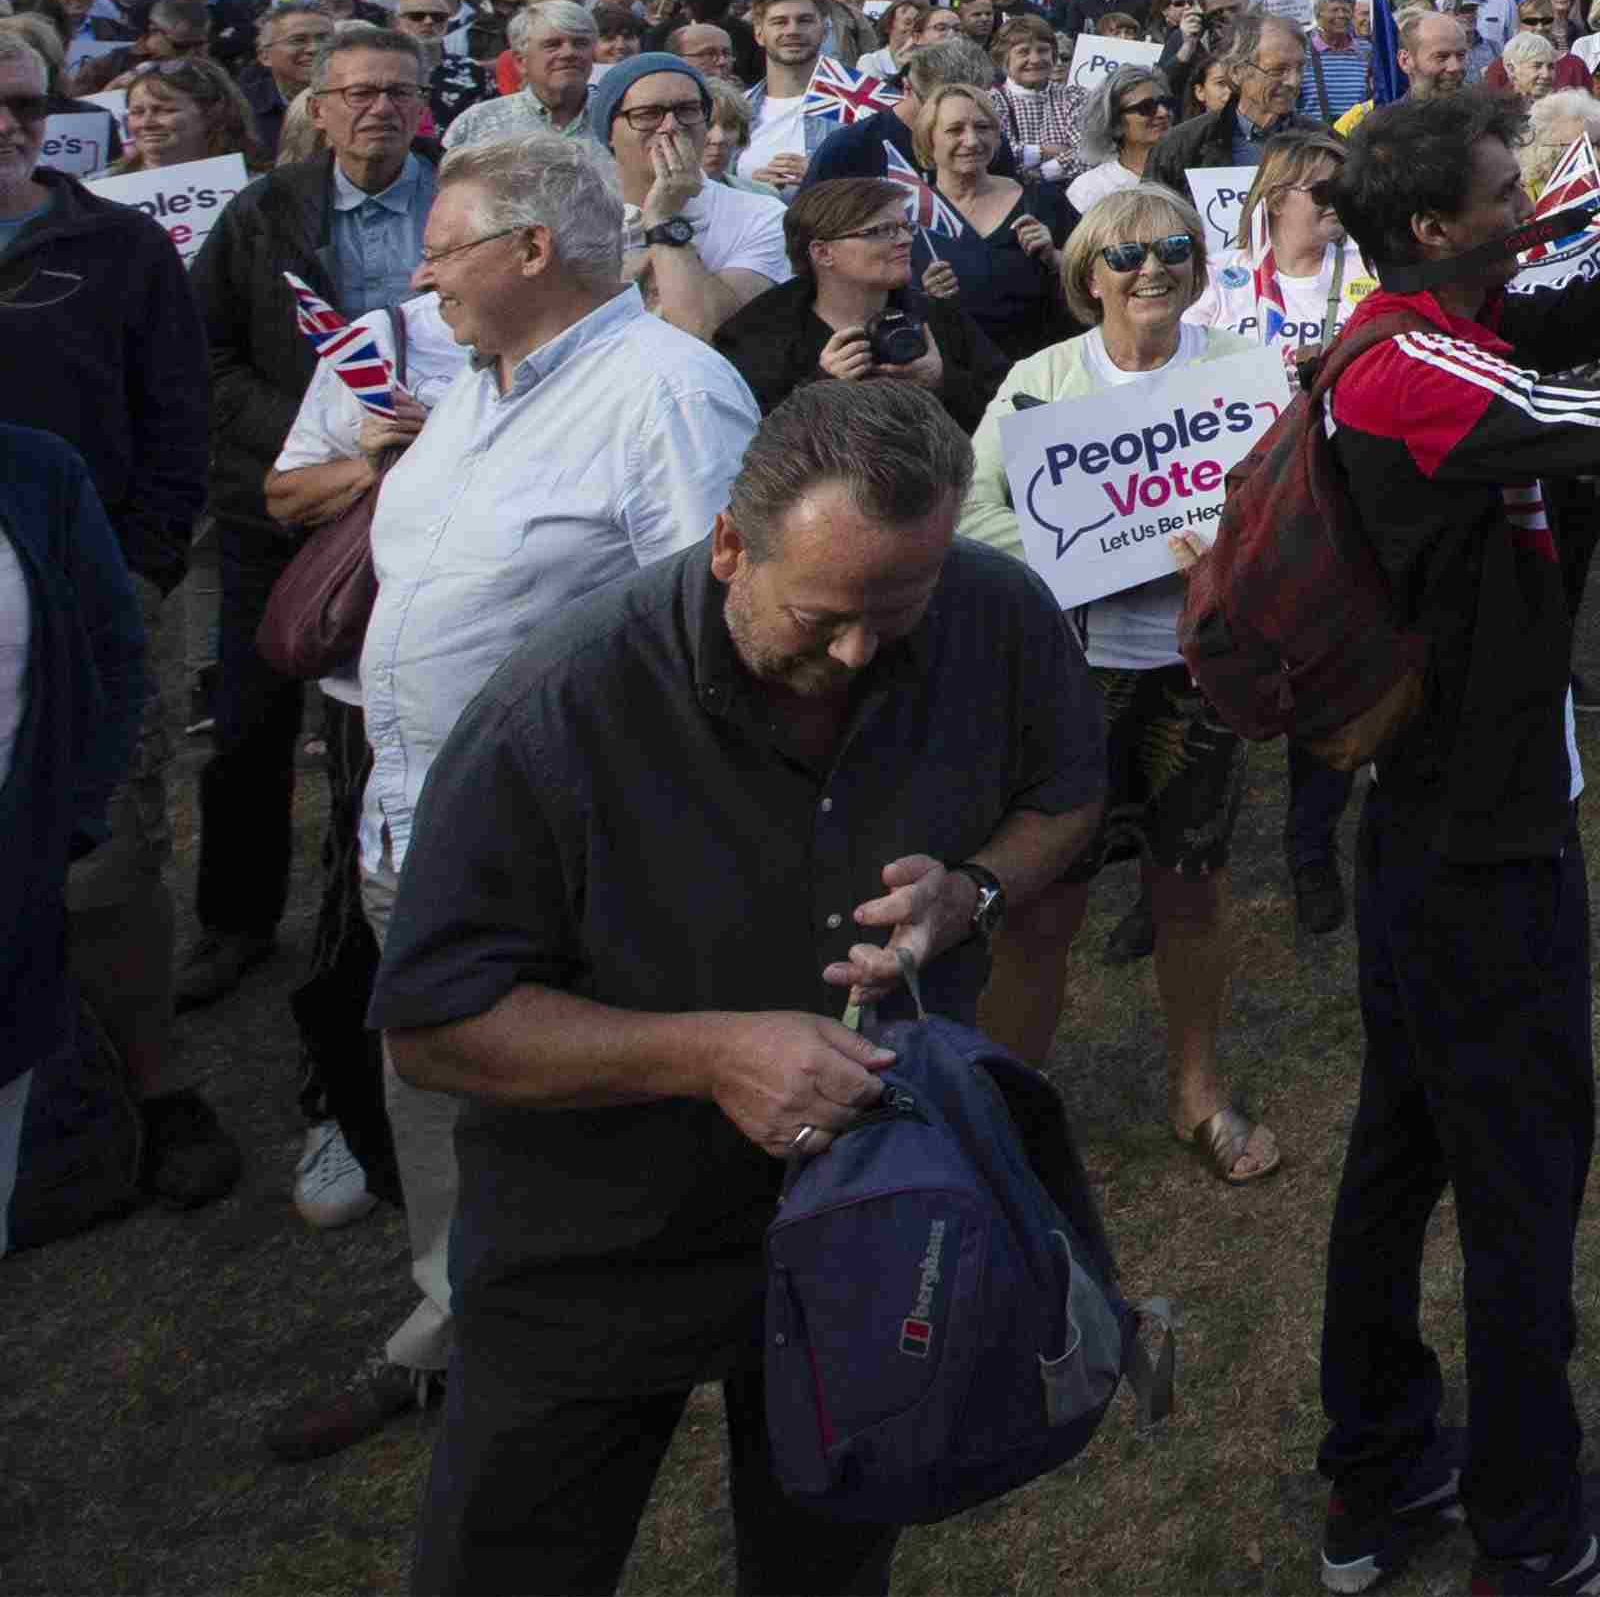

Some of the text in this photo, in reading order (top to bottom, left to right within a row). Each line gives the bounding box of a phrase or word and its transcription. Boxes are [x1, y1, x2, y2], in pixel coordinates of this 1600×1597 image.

[1045, 397, 1253, 487] People's
[1102, 459, 1225, 517] Vote
[1099, 503, 1225, 554] Let Us Be Hea
